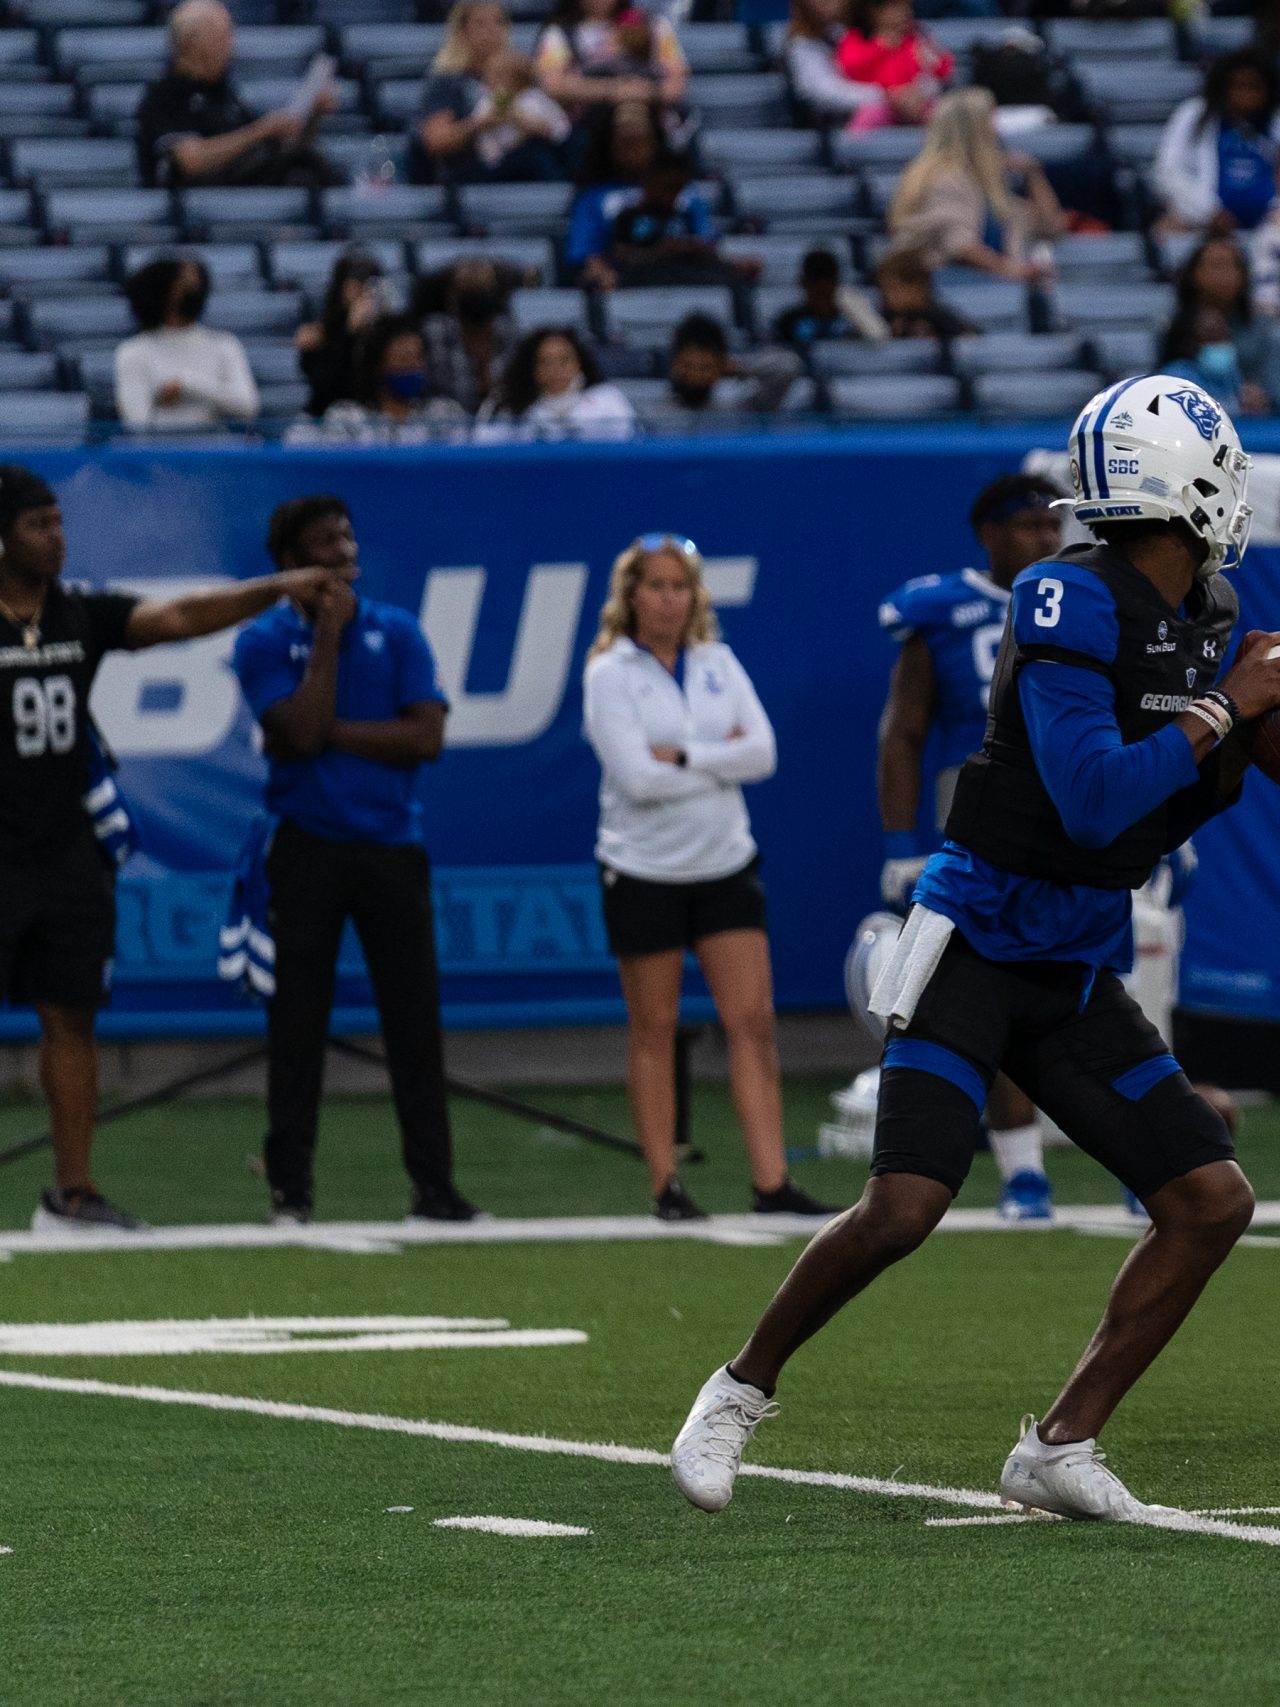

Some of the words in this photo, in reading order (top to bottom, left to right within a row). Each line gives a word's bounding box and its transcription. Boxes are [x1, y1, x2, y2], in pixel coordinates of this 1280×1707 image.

[1108, 459, 1139, 474] SBC
[1034, 577, 1064, 628] 3
[12, 672, 76, 757] 98
